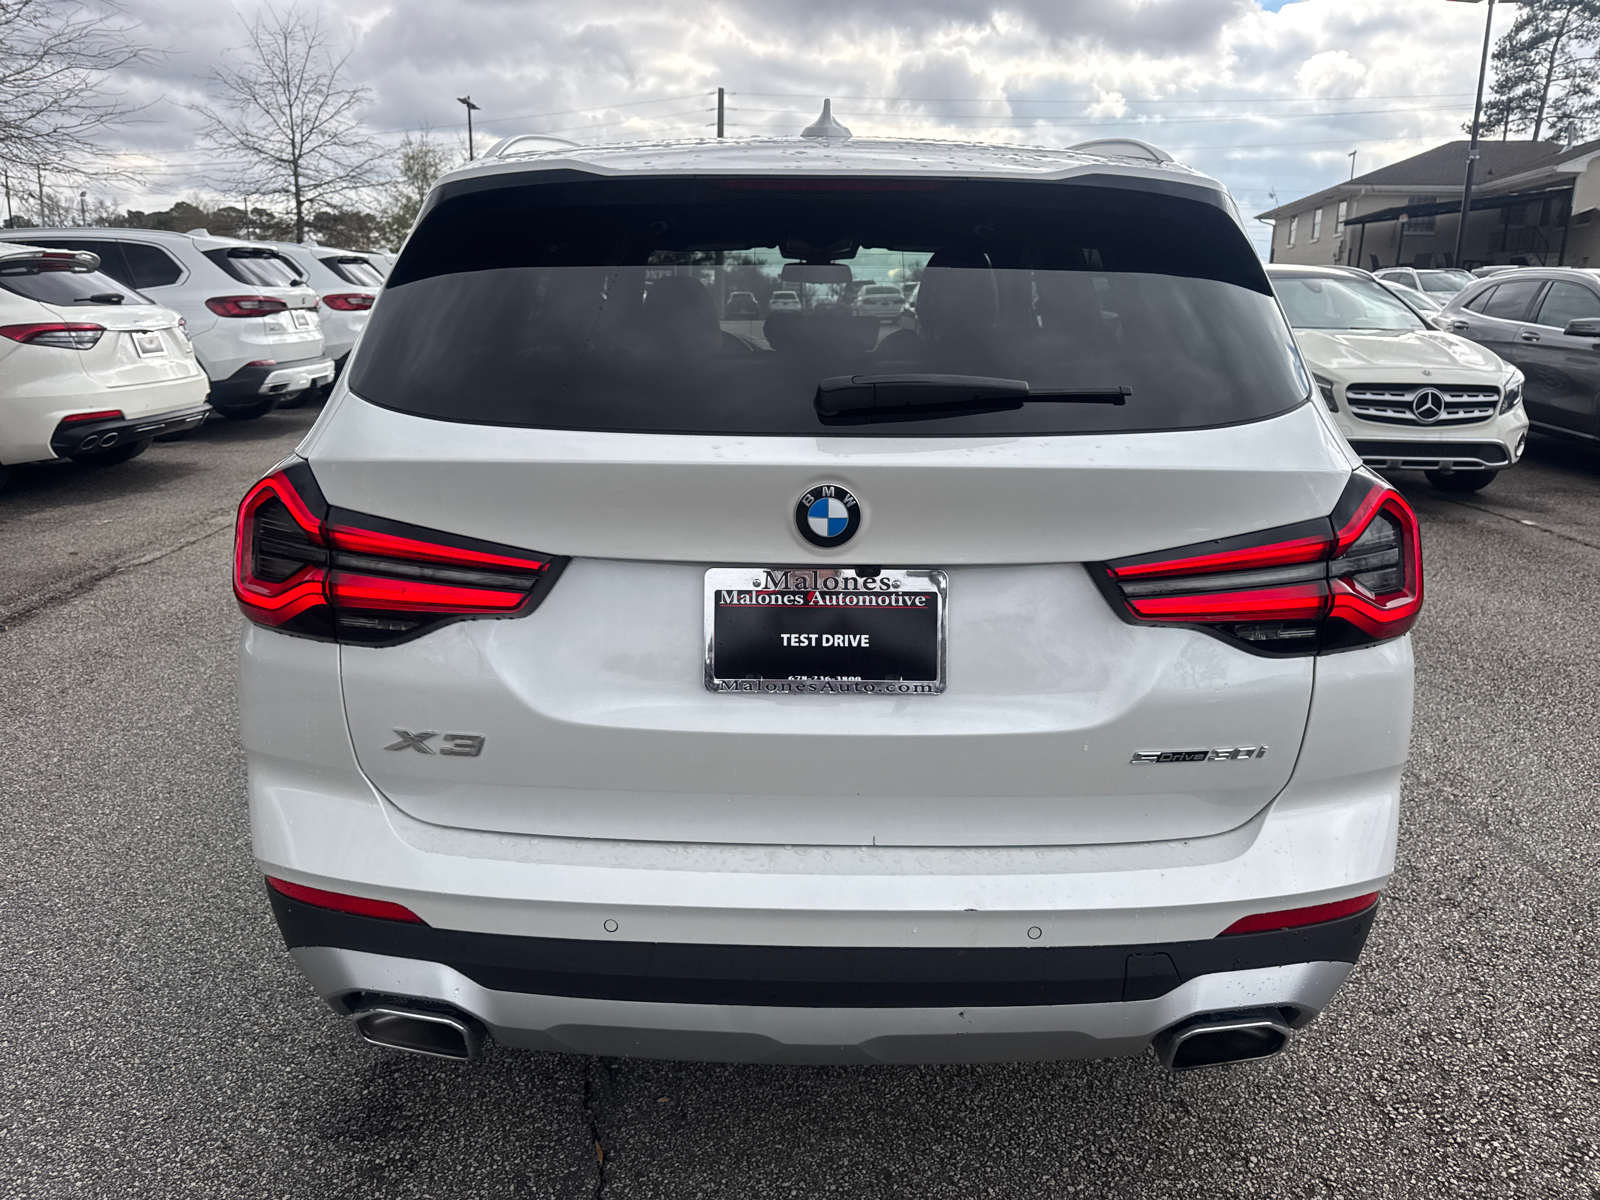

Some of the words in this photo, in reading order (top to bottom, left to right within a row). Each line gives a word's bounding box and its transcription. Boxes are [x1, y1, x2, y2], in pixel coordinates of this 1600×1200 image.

[801, 486, 857, 508] BMW
[762, 570, 891, 591] Malones
[719, 590, 804, 605] Malones
[809, 591, 926, 607] Automotive
[780, 633, 819, 647] TEST
[822, 634, 870, 647] DRIVE
[719, 680, 934, 694] MalonesAuto.com
[383, 727, 485, 757] X3
